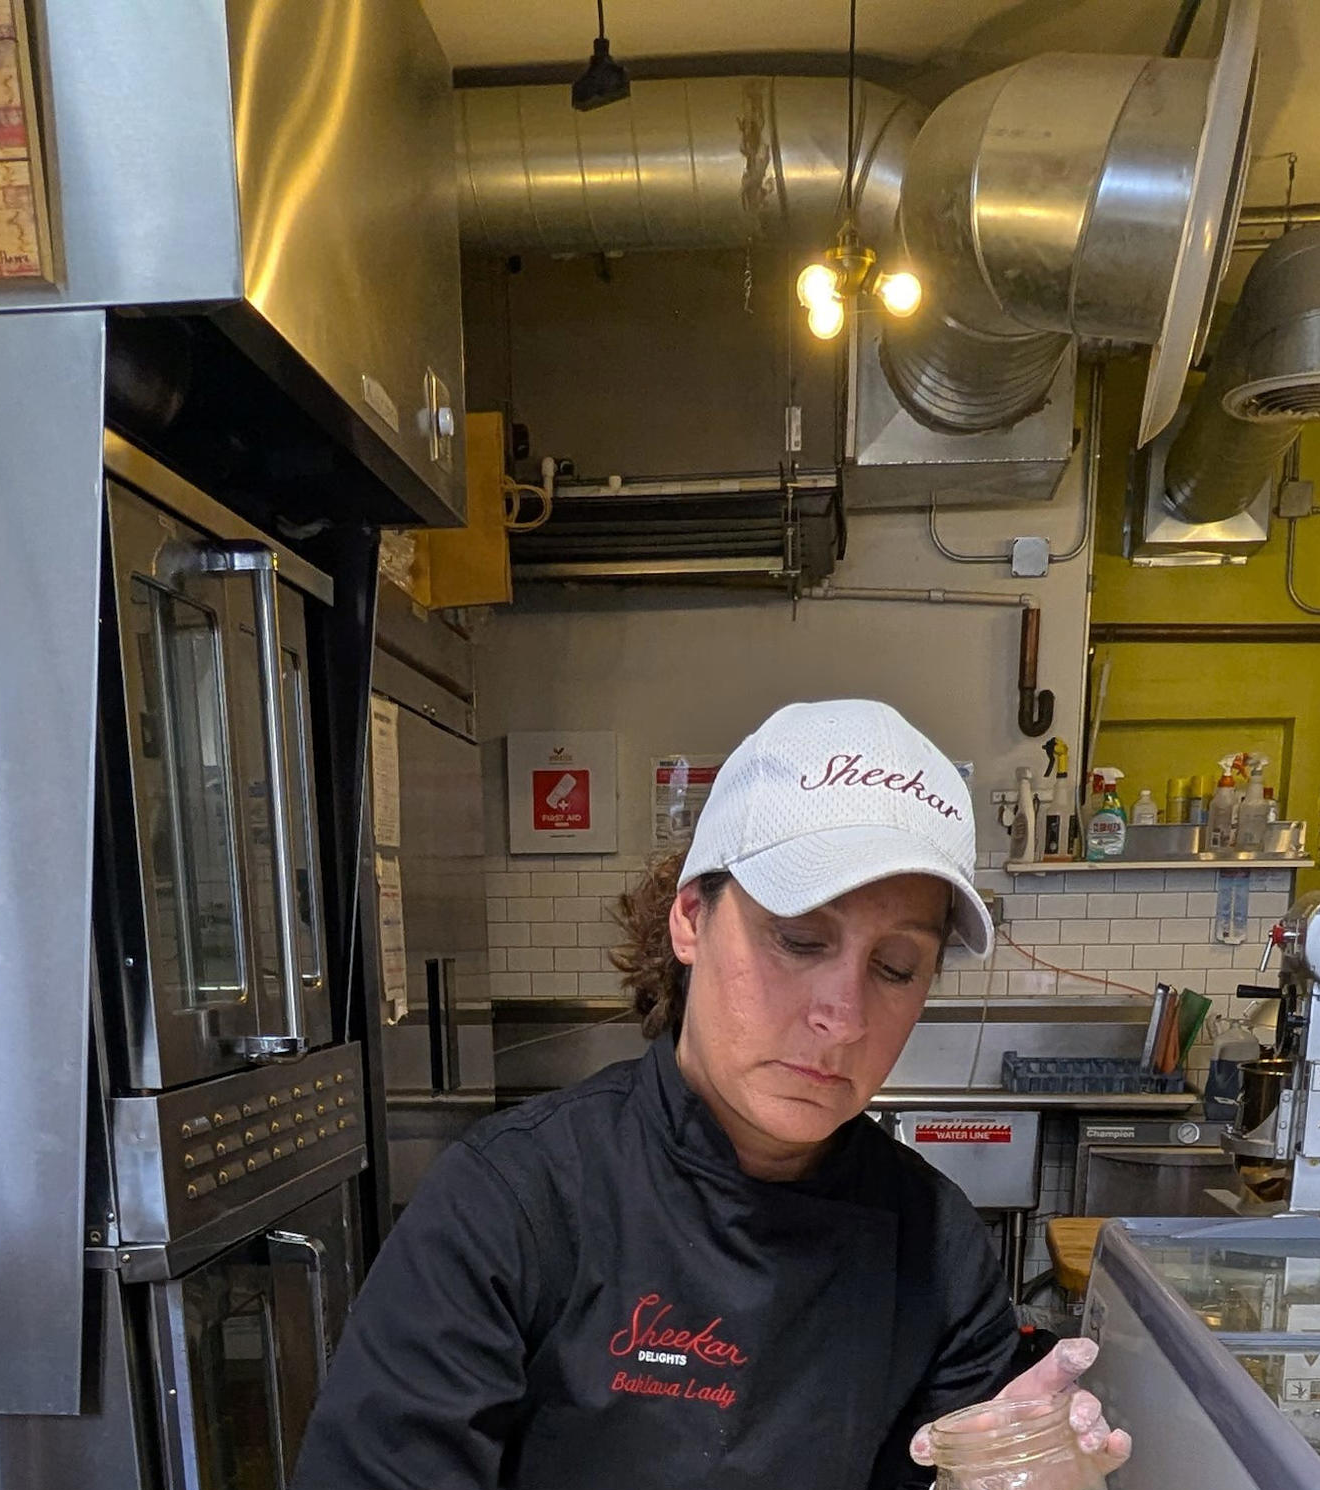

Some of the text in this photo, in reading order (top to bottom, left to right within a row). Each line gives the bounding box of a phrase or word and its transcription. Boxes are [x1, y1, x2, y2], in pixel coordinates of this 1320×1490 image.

[800, 754, 962, 821] Sheekar
[542, 814, 582, 822] FIRST AID
[937, 1131, 990, 1140] WATER LINE
[1086, 1129, 1135, 1138] Champion
[610, 1293, 748, 1366] Sheekar
[638, 1350, 687, 1366] DELIGHTS
[684, 1378, 736, 1408] Lady
